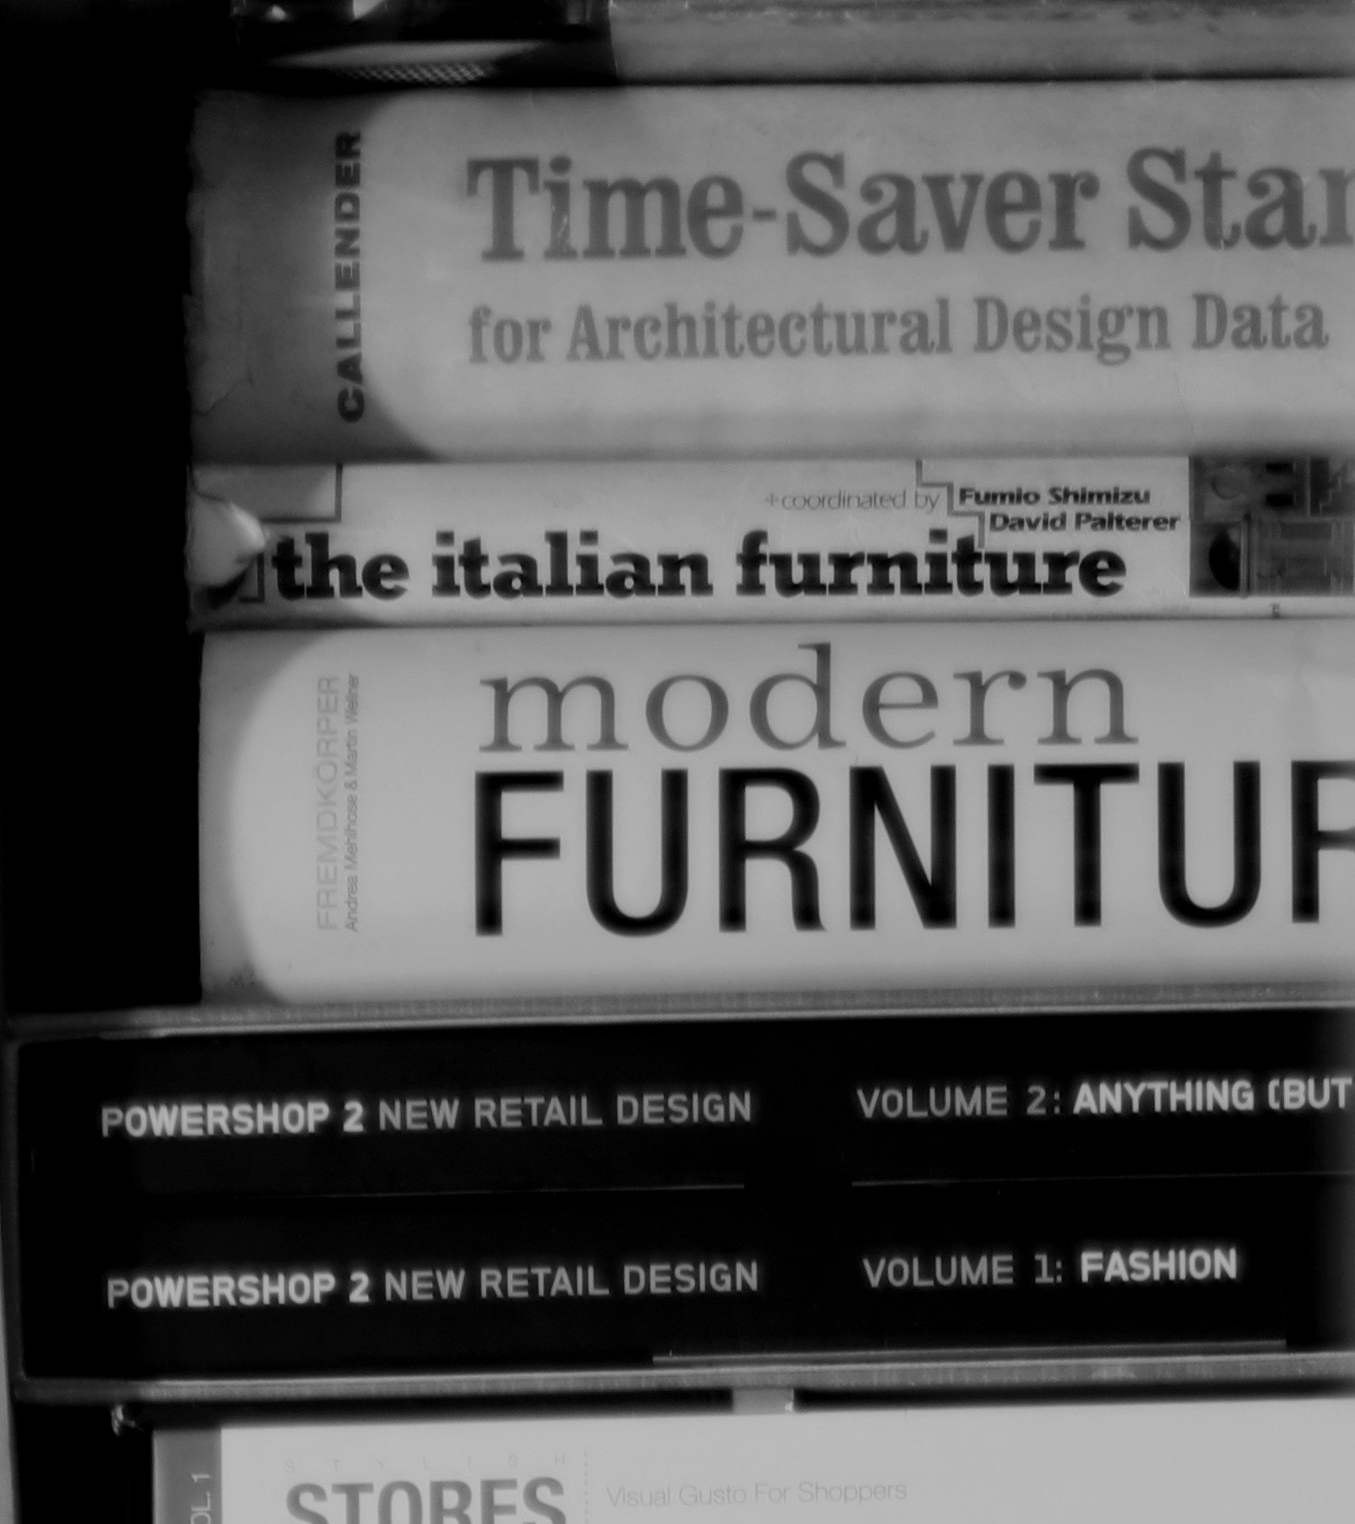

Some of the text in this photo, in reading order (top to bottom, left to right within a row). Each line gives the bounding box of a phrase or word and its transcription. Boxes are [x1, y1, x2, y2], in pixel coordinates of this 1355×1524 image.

[465, 149, 1100, 262] Time-Saver
[335, 130, 363, 423] CALLENDER
[468, 292, 1330, 366] for Architectural Design Data
[911, 489, 940, 513] by
[959, 486, 1151, 507] Fumio Shimizu
[990, 510, 1181, 532] David Palterer
[271, 526, 1127, 600] the italian furniture
[479, 642, 1139, 752] modern
[312, 674, 339, 931] FREMDKÖRPER
[345, 874, 360, 934] Andrea
[100, 1091, 752, 1137] POWERSHOP 2 NEW RETAIL DESIGN
[858, 1076, 1352, 1118] VOLUME ANYTHING (BUT
[107, 1261, 758, 1309] POWERSHOP 2 NEW RETAIL DESIGN
[863, 1248, 1237, 1288] VOLUME FASHION
[605, 1480, 908, 1509] Visual Gusto For Shoppers
